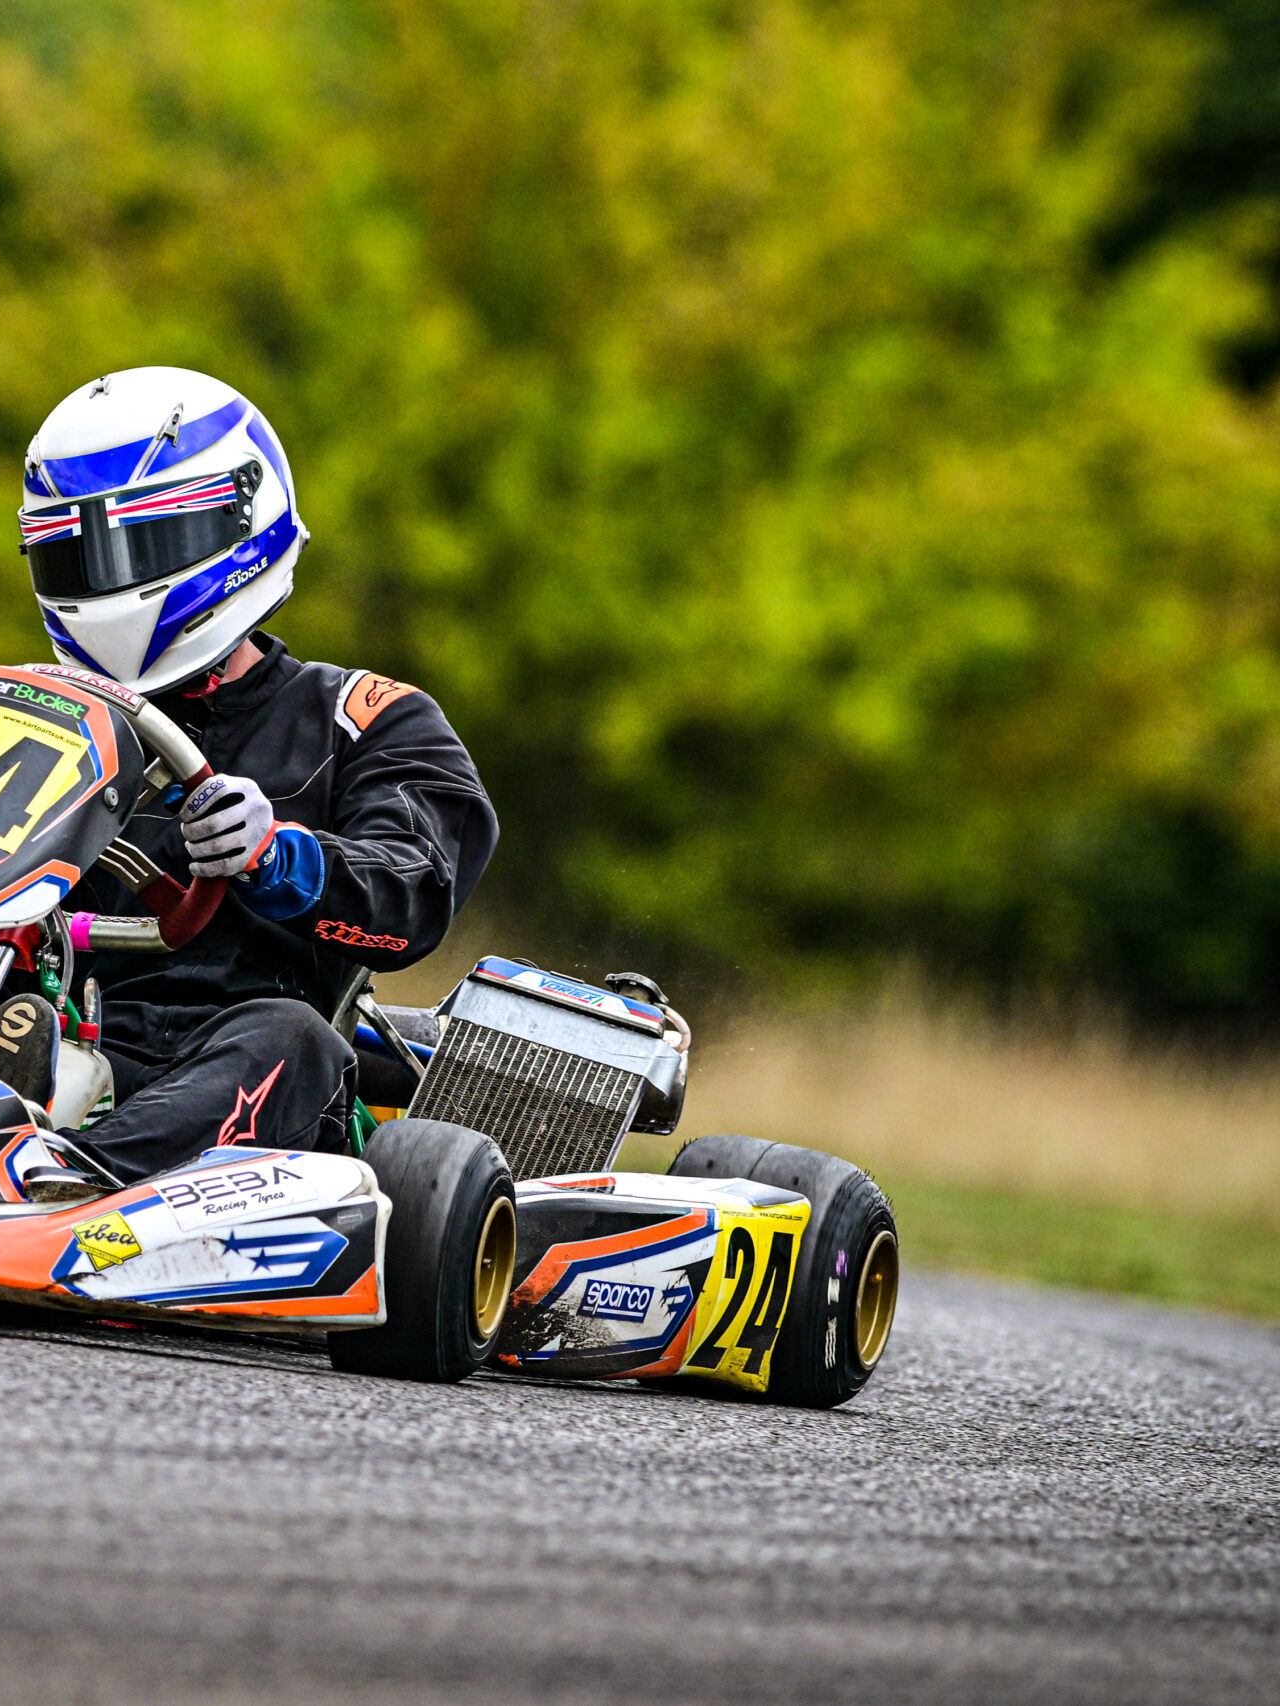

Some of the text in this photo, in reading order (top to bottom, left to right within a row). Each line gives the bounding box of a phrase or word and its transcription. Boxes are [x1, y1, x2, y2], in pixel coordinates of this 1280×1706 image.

[224, 556, 268, 594] PUDDLE
[3, 714, 82, 749] www.kartpartsuk.com
[187, 778, 226, 814] sparco
[539, 978, 601, 1001] VORTEX
[160, 1166, 304, 1209] BEBA
[202, 1191, 285, 1216] Racing Tyres
[79, 1223, 136, 1245] ibea
[586, 1282, 651, 1316] sparco
[686, 1226, 794, 1375] 24
